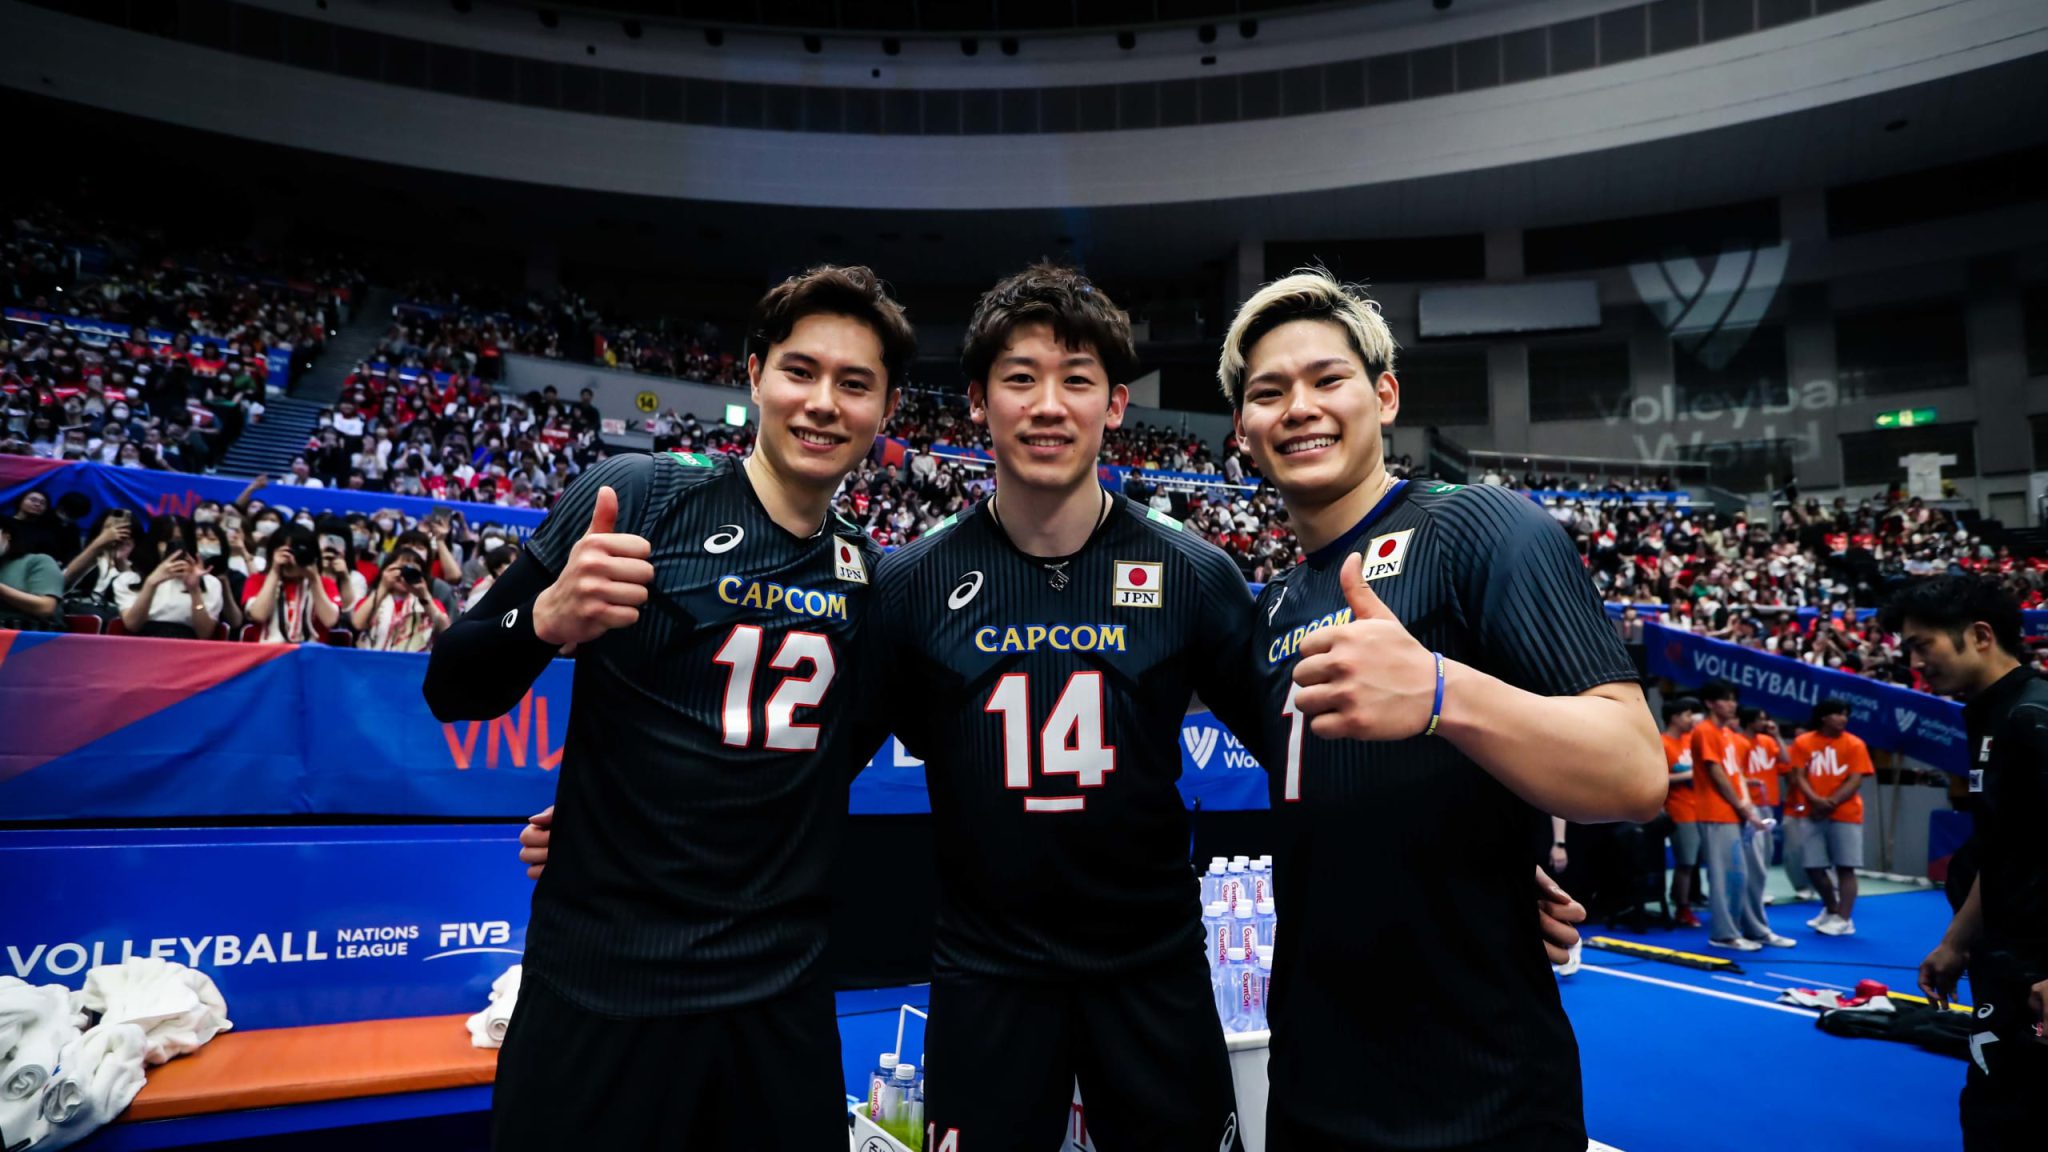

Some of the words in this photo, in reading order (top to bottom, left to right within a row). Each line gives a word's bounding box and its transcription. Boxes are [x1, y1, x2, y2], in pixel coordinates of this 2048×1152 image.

[144, 489, 202, 518] VN
[840, 566, 863, 580] JPN
[1366, 561, 1399, 579] JPN
[717, 575, 849, 620] CAPCOM
[1121, 591, 1156, 604] JPN
[974, 624, 1127, 652] CAPCOM
[711, 623, 837, 751] 12
[1693, 650, 1819, 706] VOLLEYBALL
[442, 687, 566, 771] VNL
[983, 670, 1117, 790] 14
[336, 926, 419, 943] NATIONS
[439, 920, 511, 948] FIVB
[336, 942, 408, 959] LEAGUE
[927, 1121, 960, 1152] 14
